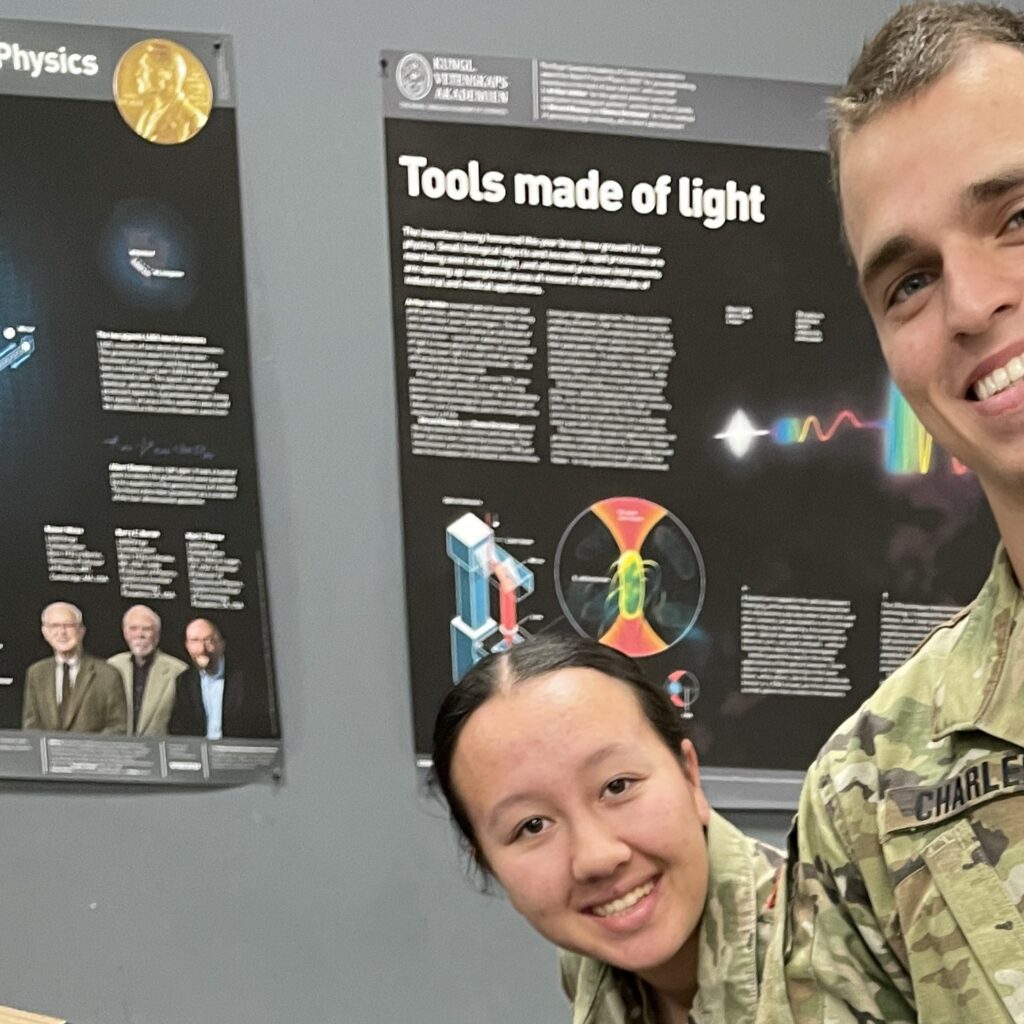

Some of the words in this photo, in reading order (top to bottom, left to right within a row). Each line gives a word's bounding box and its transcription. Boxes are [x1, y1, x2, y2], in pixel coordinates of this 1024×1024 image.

[0, 41, 99, 78] Physics
[399, 155, 506, 202] Tools
[514, 169, 624, 211] made
[631, 175, 672, 215] of
[678, 177, 765, 229] light
